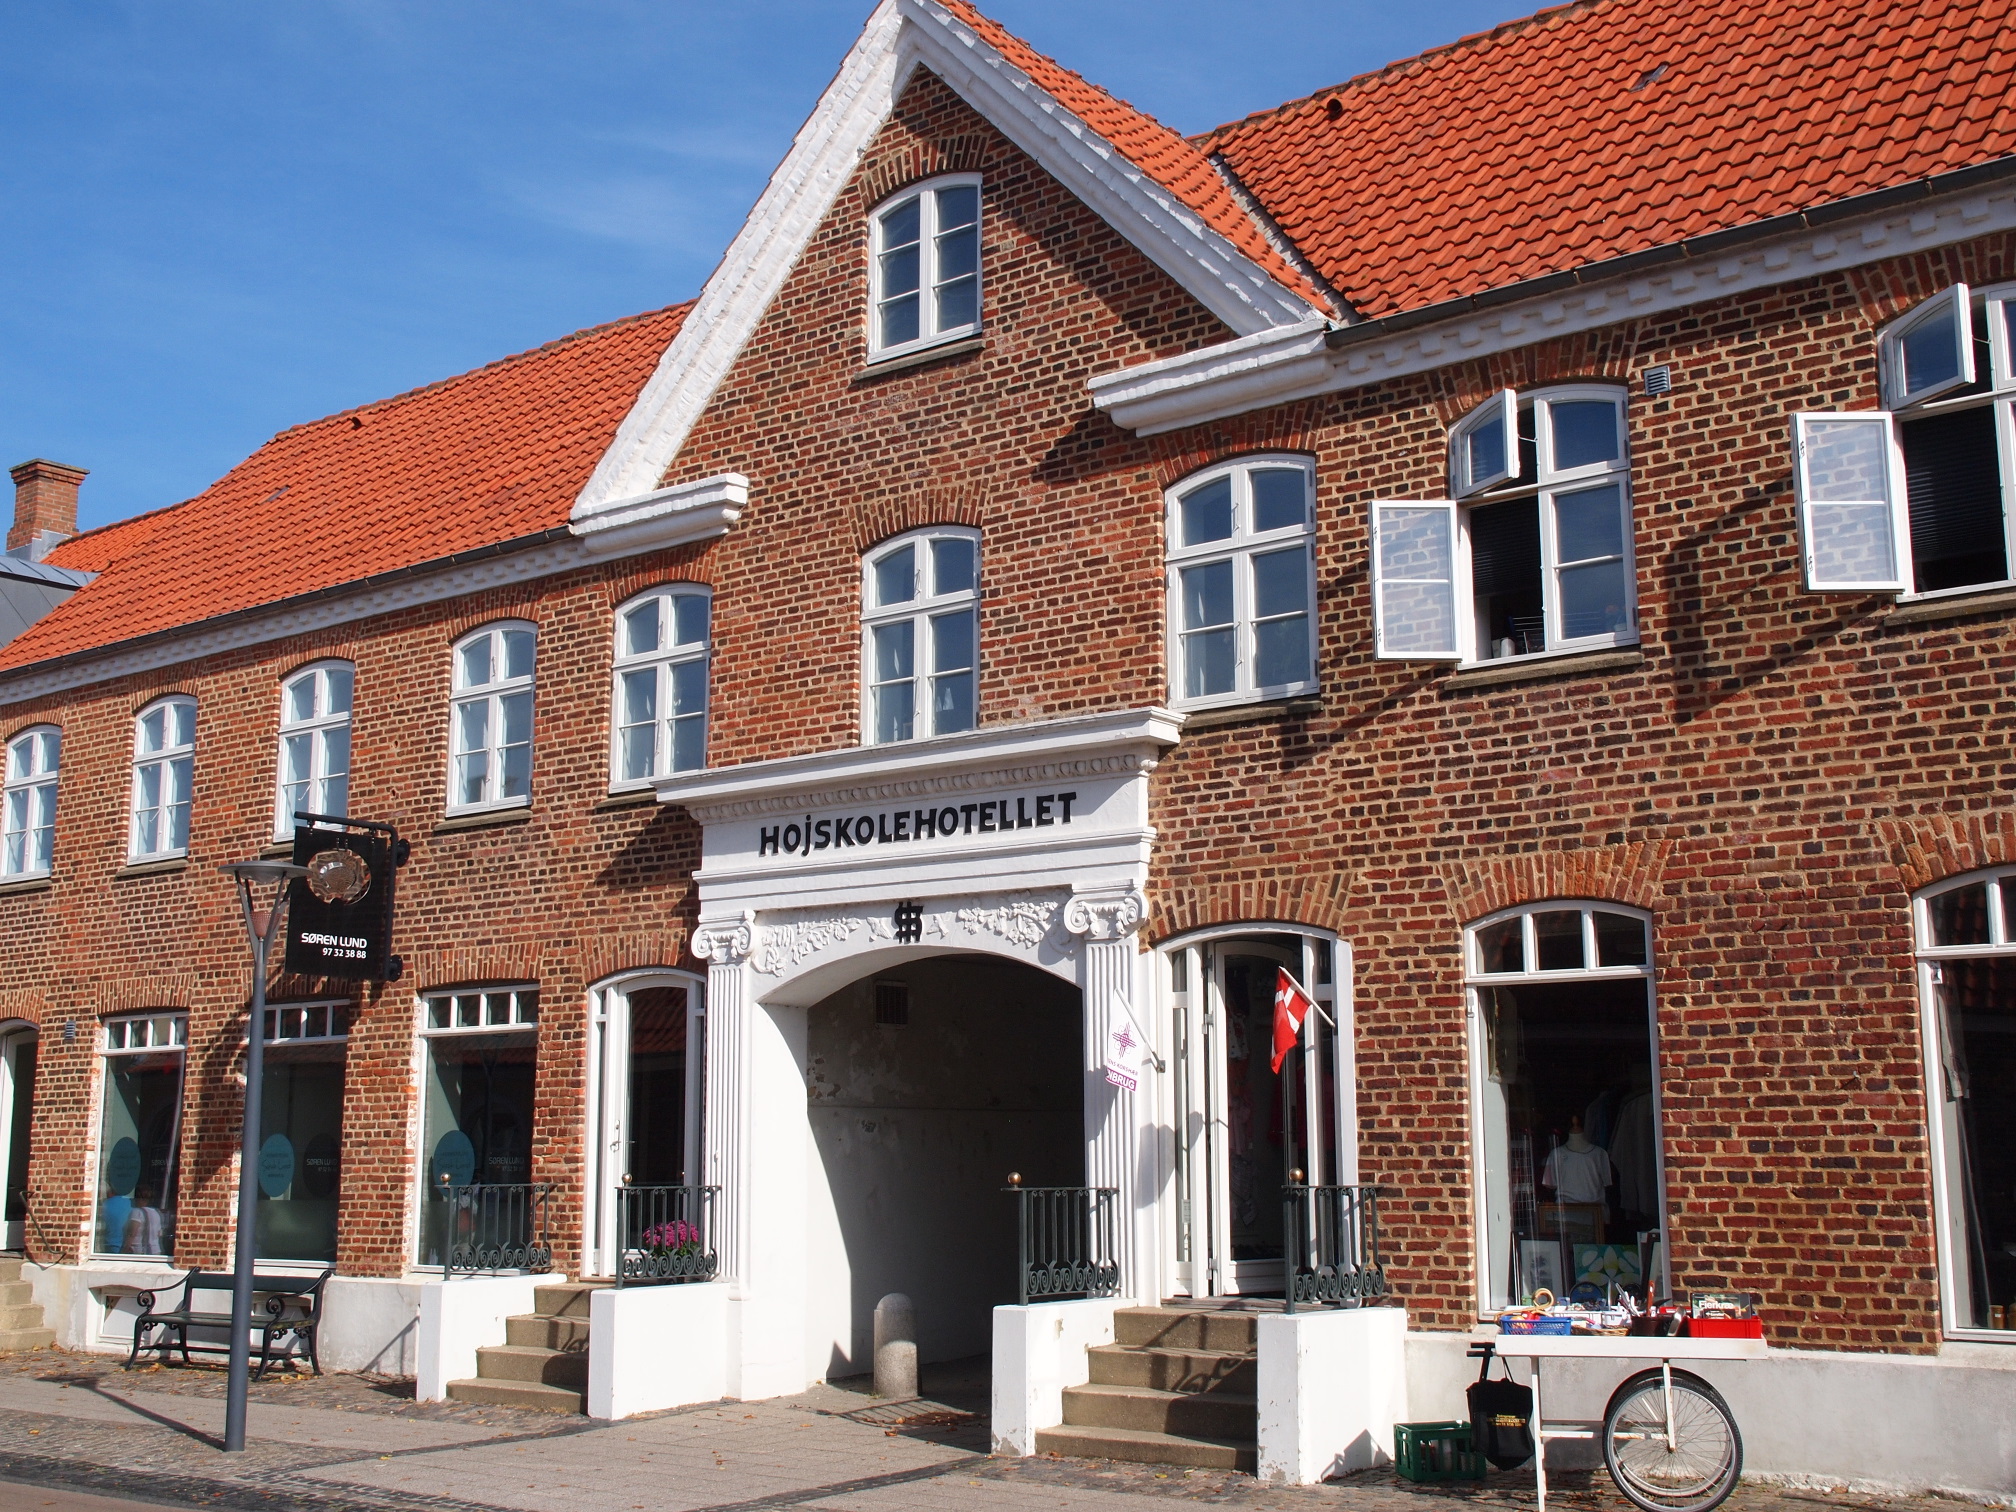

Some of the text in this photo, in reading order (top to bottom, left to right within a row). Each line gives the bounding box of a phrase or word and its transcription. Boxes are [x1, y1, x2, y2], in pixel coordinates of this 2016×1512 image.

[301, 932, 368, 949] SØREN LUND
[322, 947, 367, 959] 97 32 38 88
